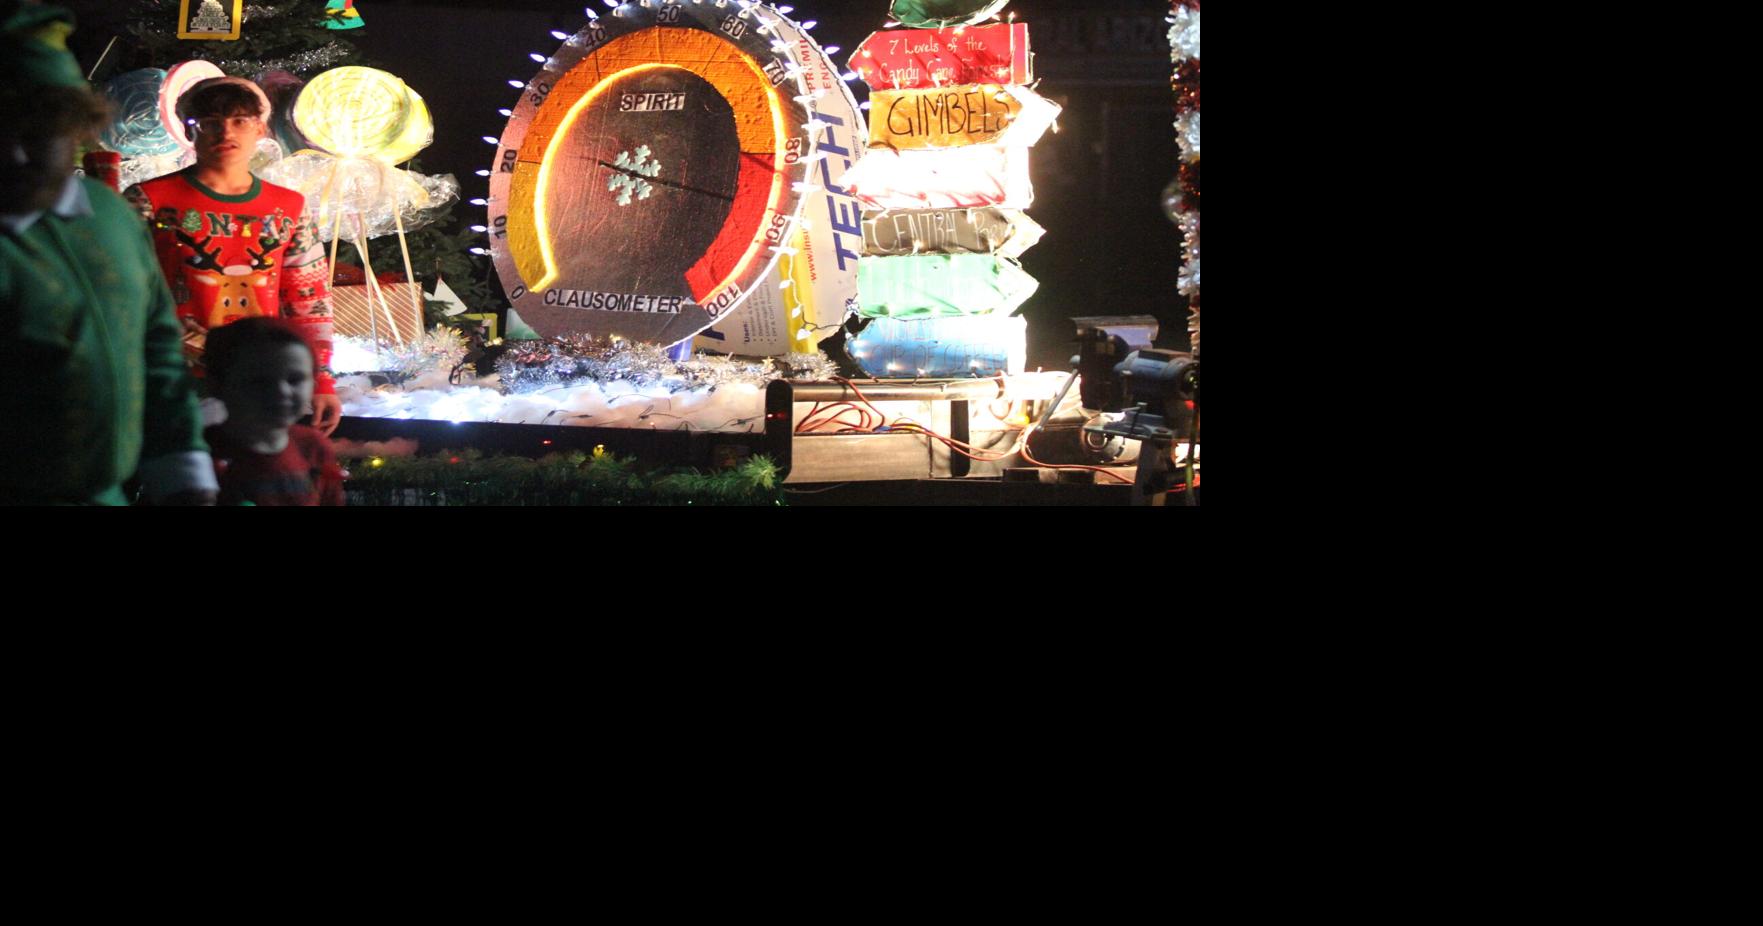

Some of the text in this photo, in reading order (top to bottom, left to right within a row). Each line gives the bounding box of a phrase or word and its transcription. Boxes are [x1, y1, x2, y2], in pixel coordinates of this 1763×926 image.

[658, 6, 679, 22] 50
[585, 26, 607, 48] 40
[721, 17, 745, 38] 60
[889, 35, 987, 55] 7 Levels of the
[764, 60, 786, 86] 70
[879, 59, 919, 84] Candy
[530, 82, 550, 107] 30
[621, 93, 685, 112] SPIRIT
[887, 90, 1011, 137] GIMBELS
[501, 150, 517, 173] 20
[784, 138, 800, 164] 80
[494, 215, 508, 239] 10
[765, 213, 786, 241] 90
[511, 285, 525, 300] 0
[544, 288, 682, 313] CLAUSOMETER
[706, 285, 739, 317] 100
